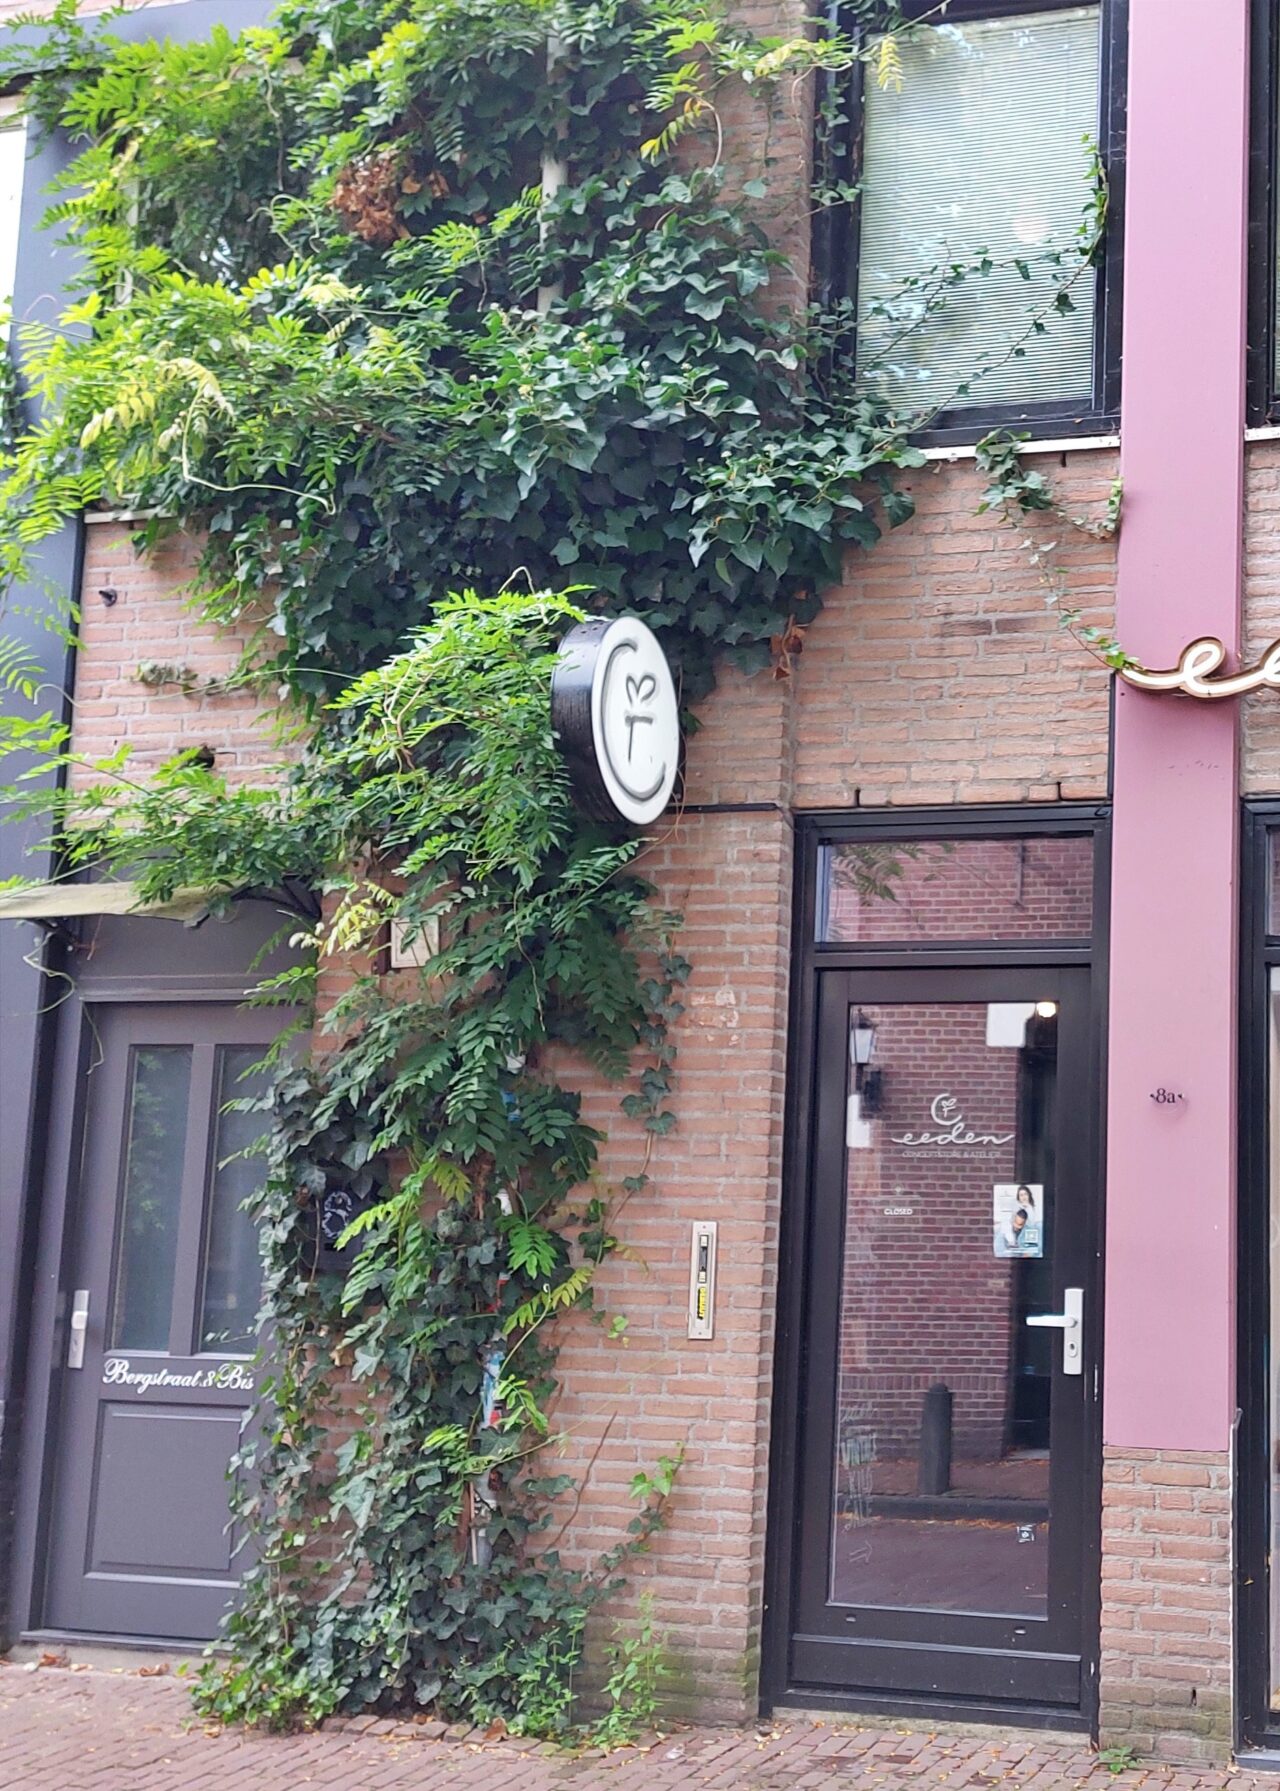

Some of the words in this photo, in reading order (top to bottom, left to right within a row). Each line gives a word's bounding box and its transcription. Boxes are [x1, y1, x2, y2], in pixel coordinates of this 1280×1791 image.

[1156, 1088, 1176, 1104] 8a
[891, 1122, 1015, 1146] eeden
[884, 1208, 913, 1216] CLOSED
[102, 1358, 201, 1394] Bergstraat
[217, 1363, 254, 1390] Bis
